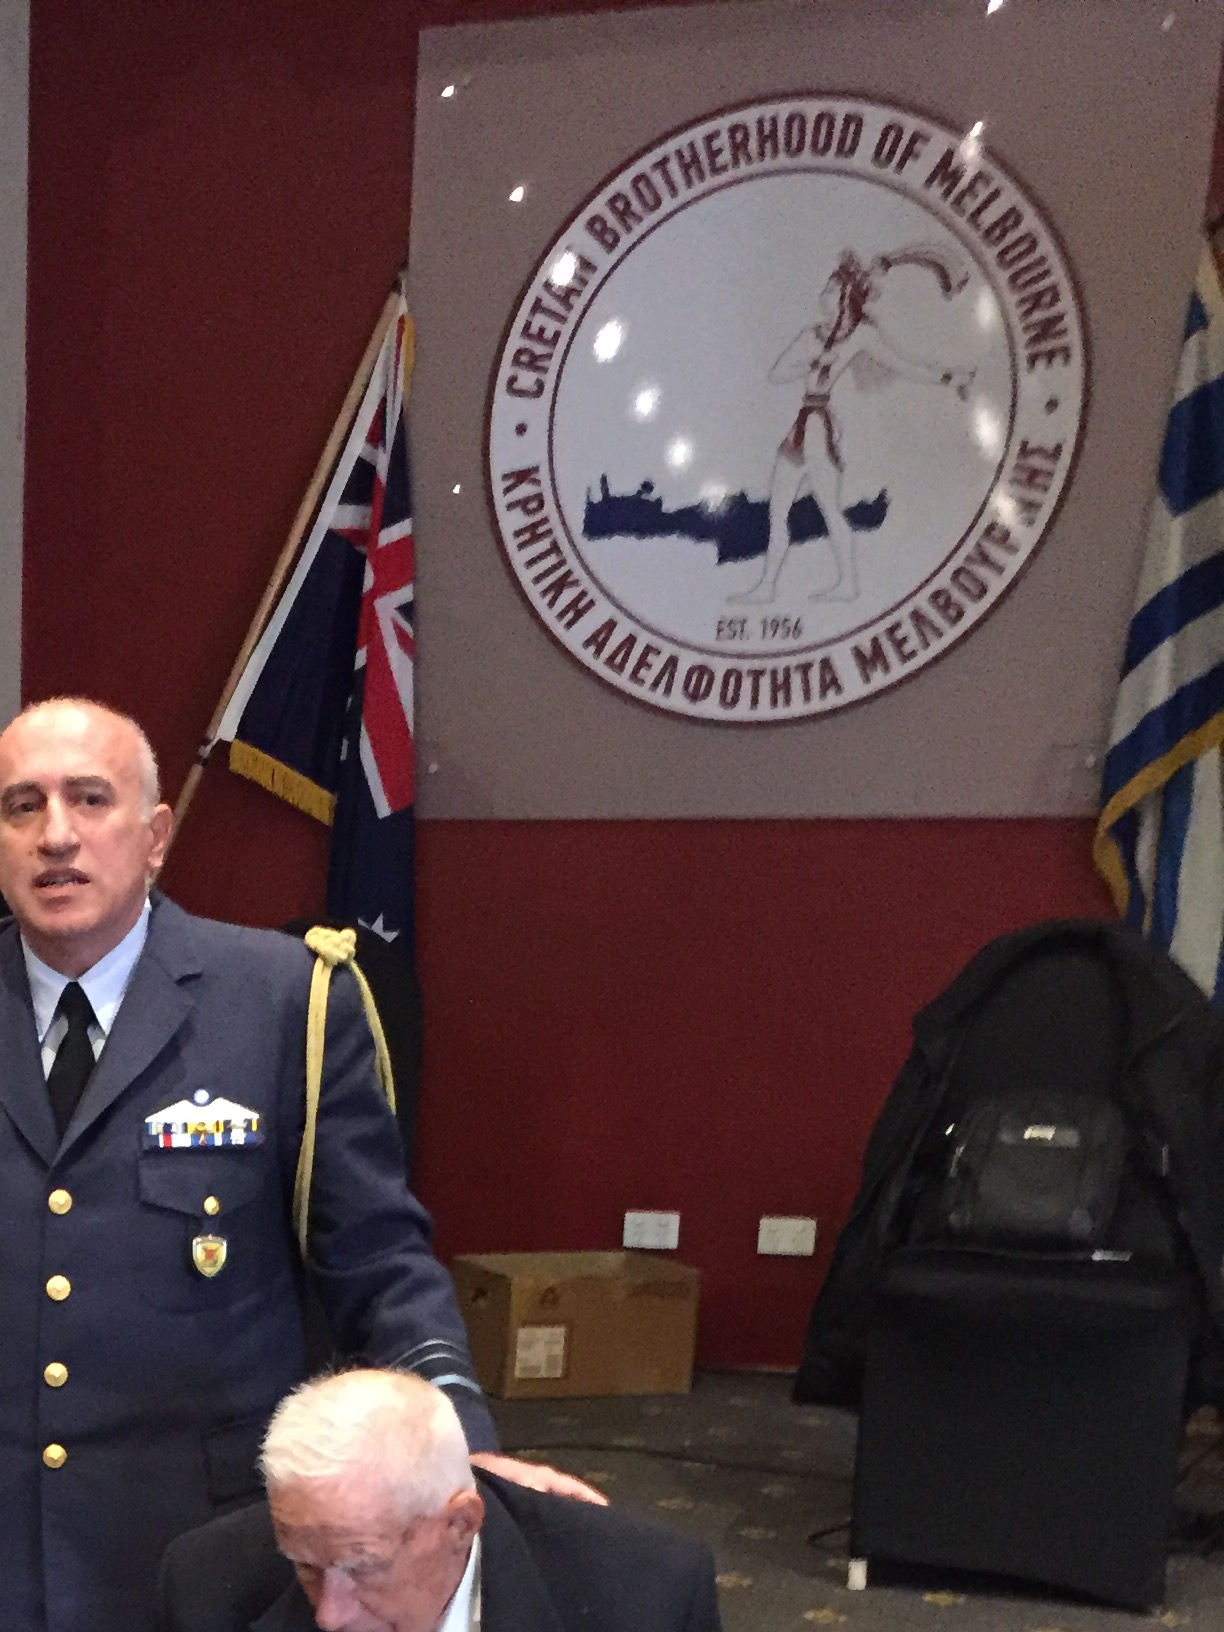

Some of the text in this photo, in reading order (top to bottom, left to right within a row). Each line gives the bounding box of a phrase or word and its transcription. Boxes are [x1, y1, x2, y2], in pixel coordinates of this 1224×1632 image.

[584, 111, 864, 254] BROTHERHOOD
[871, 122, 933, 175] OF
[923, 146, 1072, 374] MELBOURNE
[501, 465, 597, 631] ΚΡΗΤΙΚΗ
[582, 616, 845, 711] ΑΔΕΛΦΟΤΗΤΑ
[715, 614, 804, 641] EST. 1956
